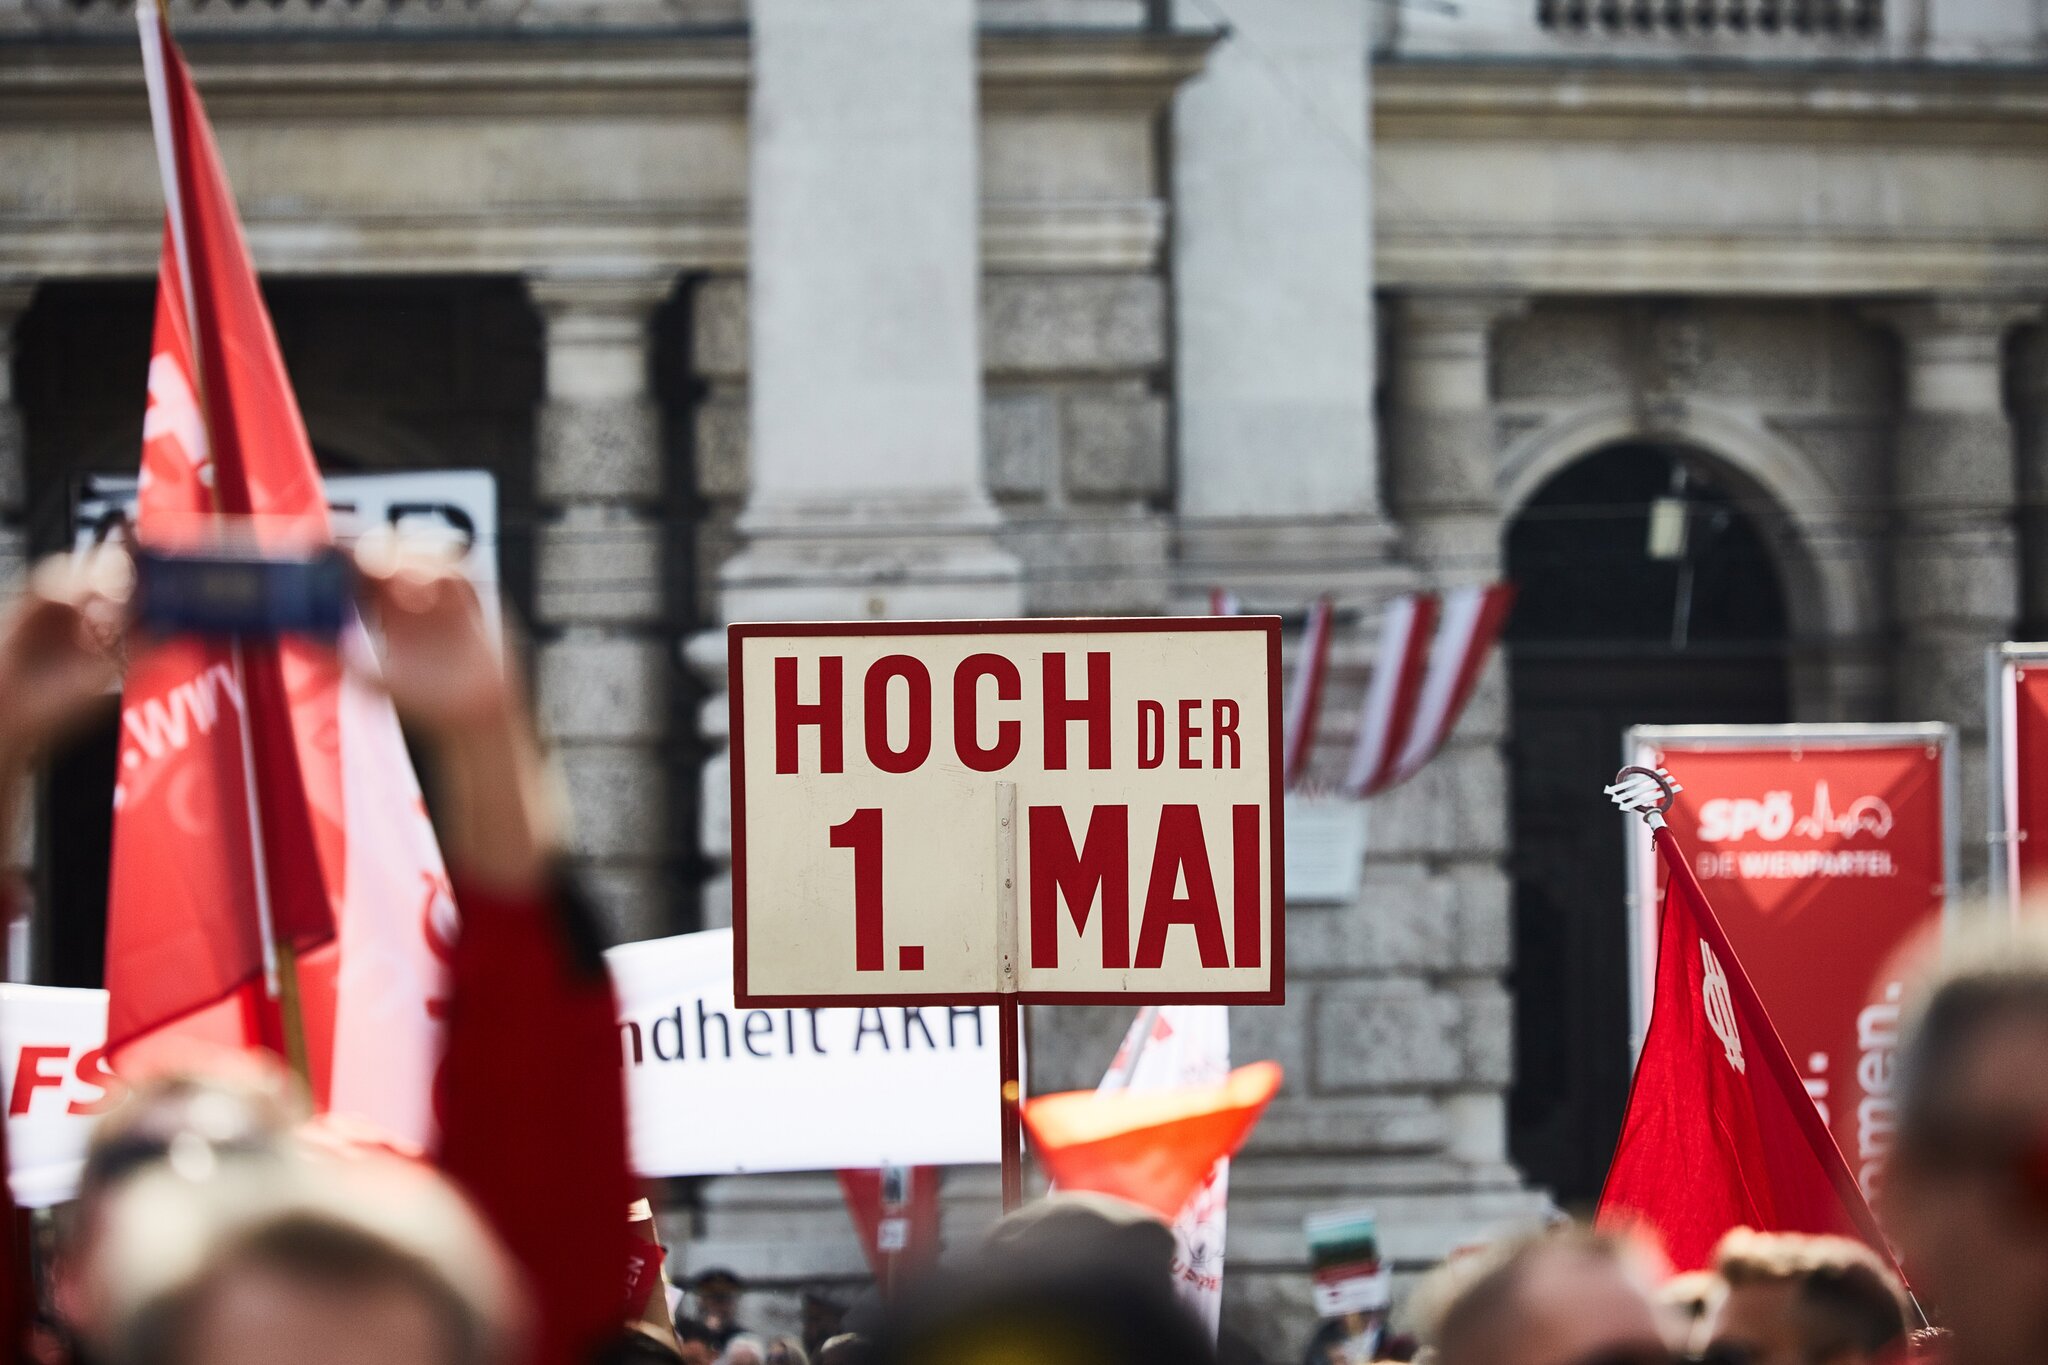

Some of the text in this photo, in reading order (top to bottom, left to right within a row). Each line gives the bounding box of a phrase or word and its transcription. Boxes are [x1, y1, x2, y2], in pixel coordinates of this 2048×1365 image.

[775, 651, 1241, 775] HOCH DER
[1698, 790, 1795, 842] SPÖ
[829, 803, 1262, 972] 1. MAI
